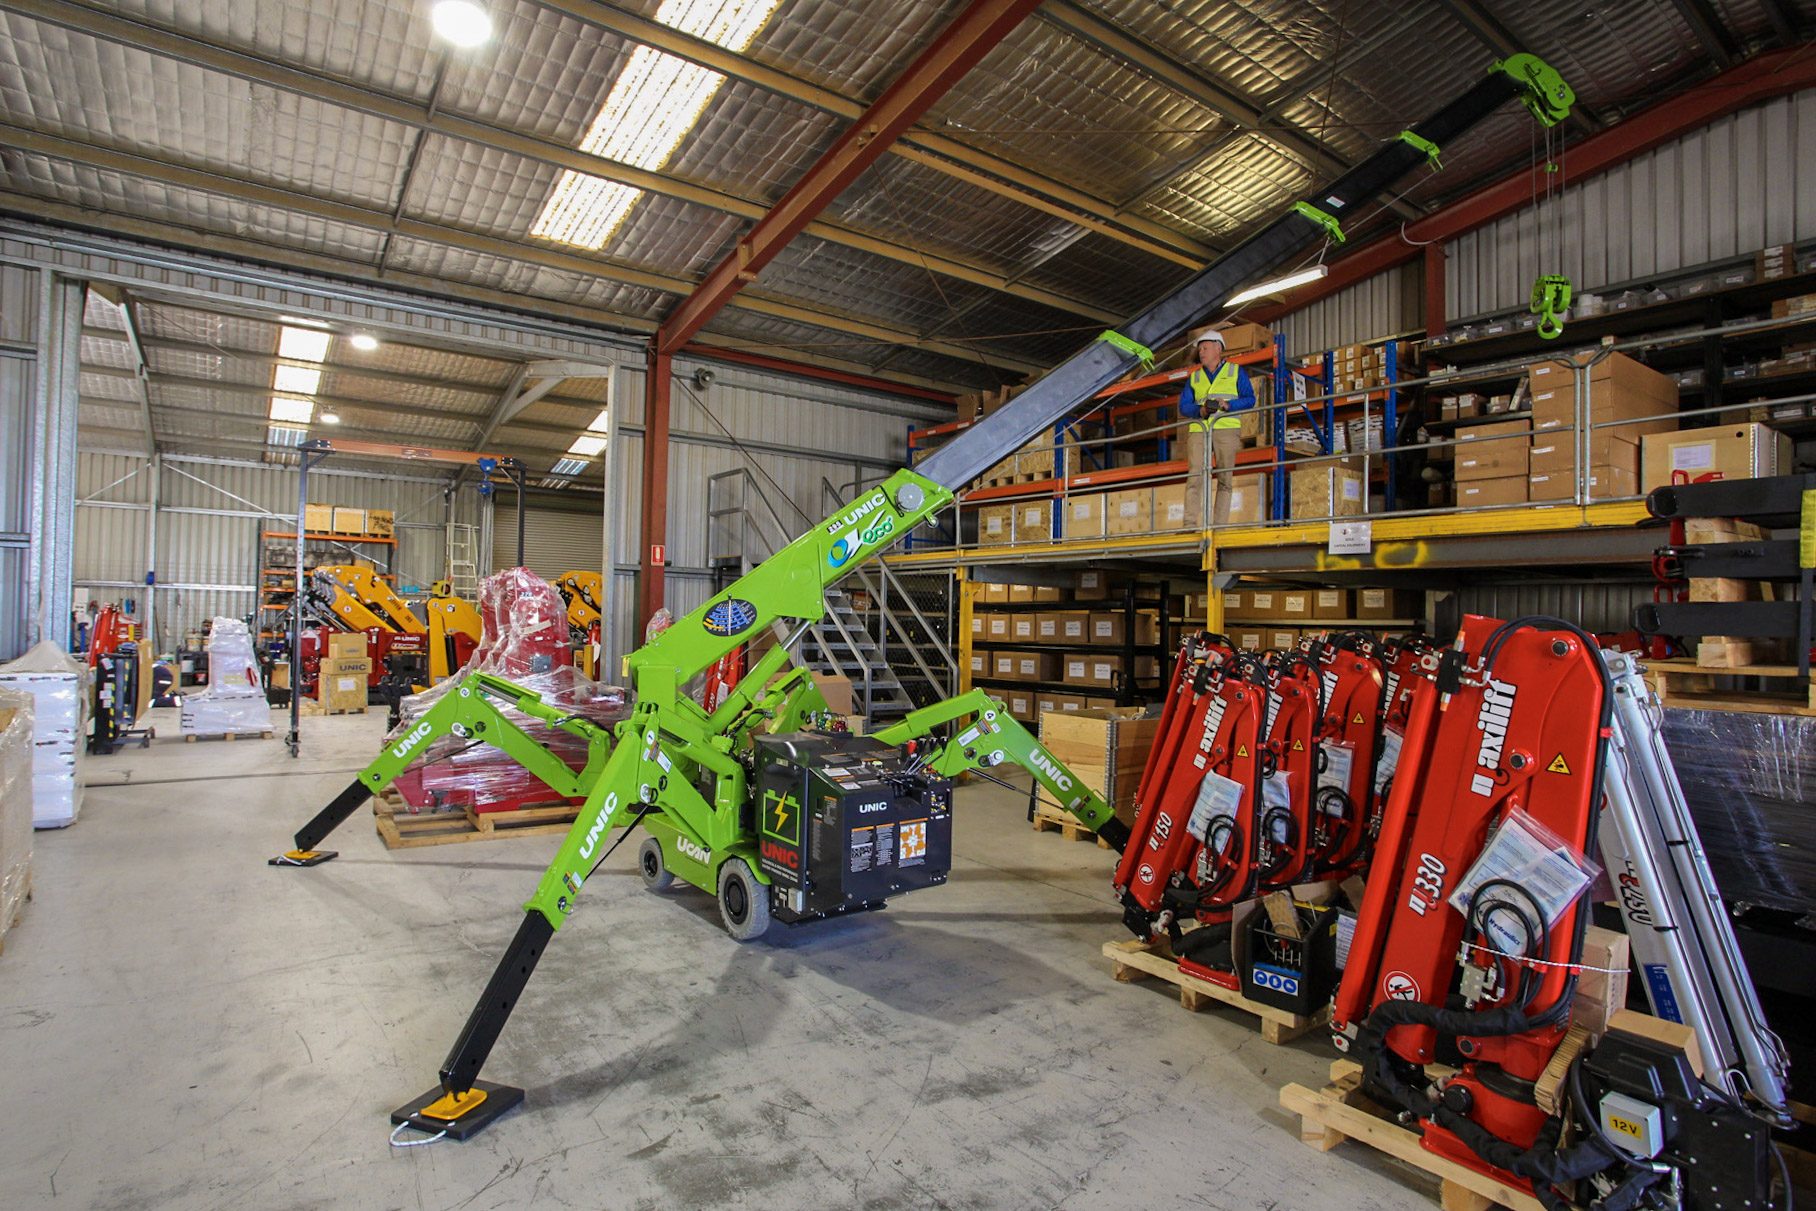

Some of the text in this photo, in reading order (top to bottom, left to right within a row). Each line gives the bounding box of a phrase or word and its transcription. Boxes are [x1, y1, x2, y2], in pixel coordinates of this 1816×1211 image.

[843, 493, 886, 525] UNIC
[338, 663, 367, 672] UNIC
[392, 721, 432, 758] UNIC
[1471, 679, 1518, 798] maxilift
[1029, 748, 1073, 792] UNIC
[859, 801, 888, 814] UNIC
[579, 791, 618, 860] UNIC
[760, 840, 799, 869] UNIC
[1612, 1119, 1637, 1135] 12V
